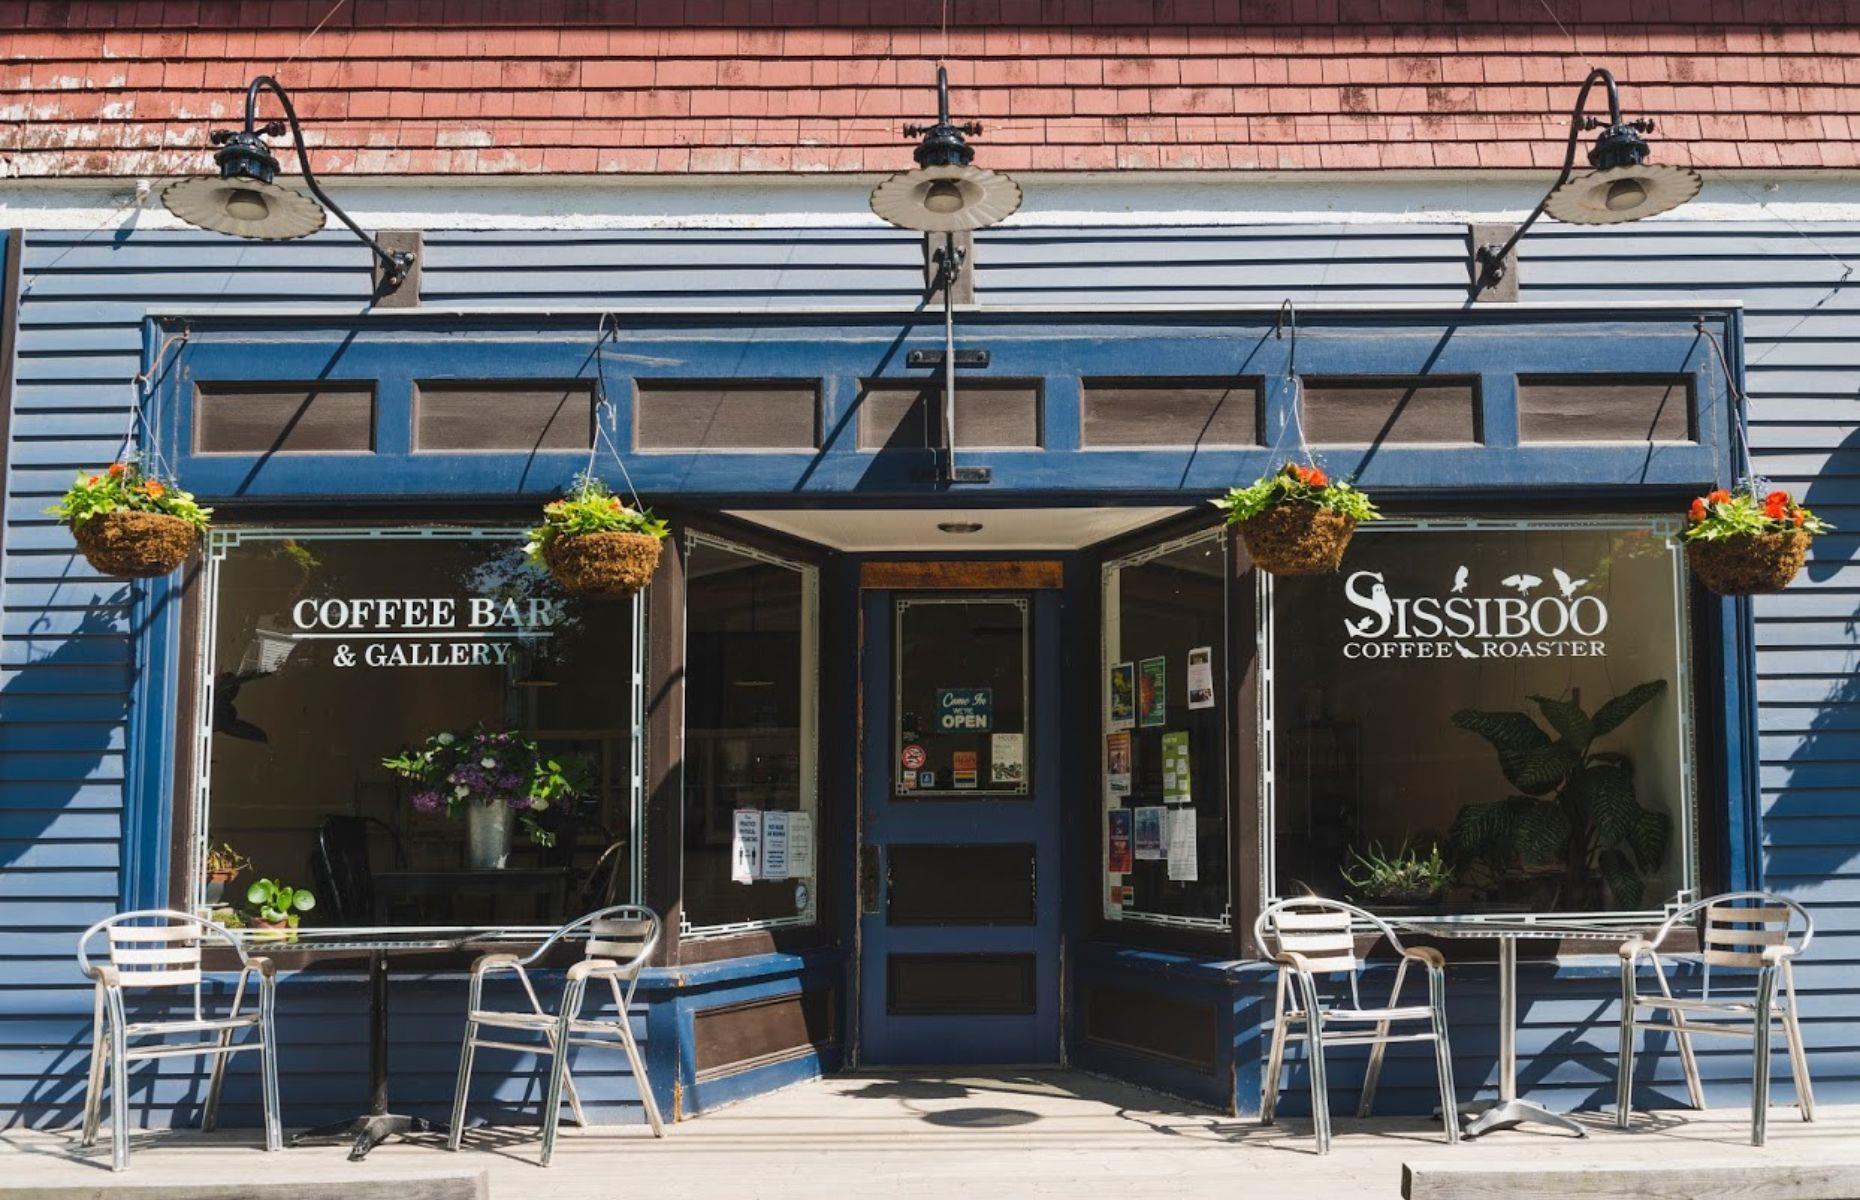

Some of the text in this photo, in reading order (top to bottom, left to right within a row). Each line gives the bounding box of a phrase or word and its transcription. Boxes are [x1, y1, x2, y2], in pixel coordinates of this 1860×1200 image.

[292, 597, 554, 629] COFFEE BAR
[1343, 571, 1608, 639] SISSIBOO
[333, 643, 511, 667] & GALLERY
[1343, 641, 1608, 658] COFFEE ROASTER
[942, 692, 970, 708] Come
[942, 714, 987, 728] OPEN
